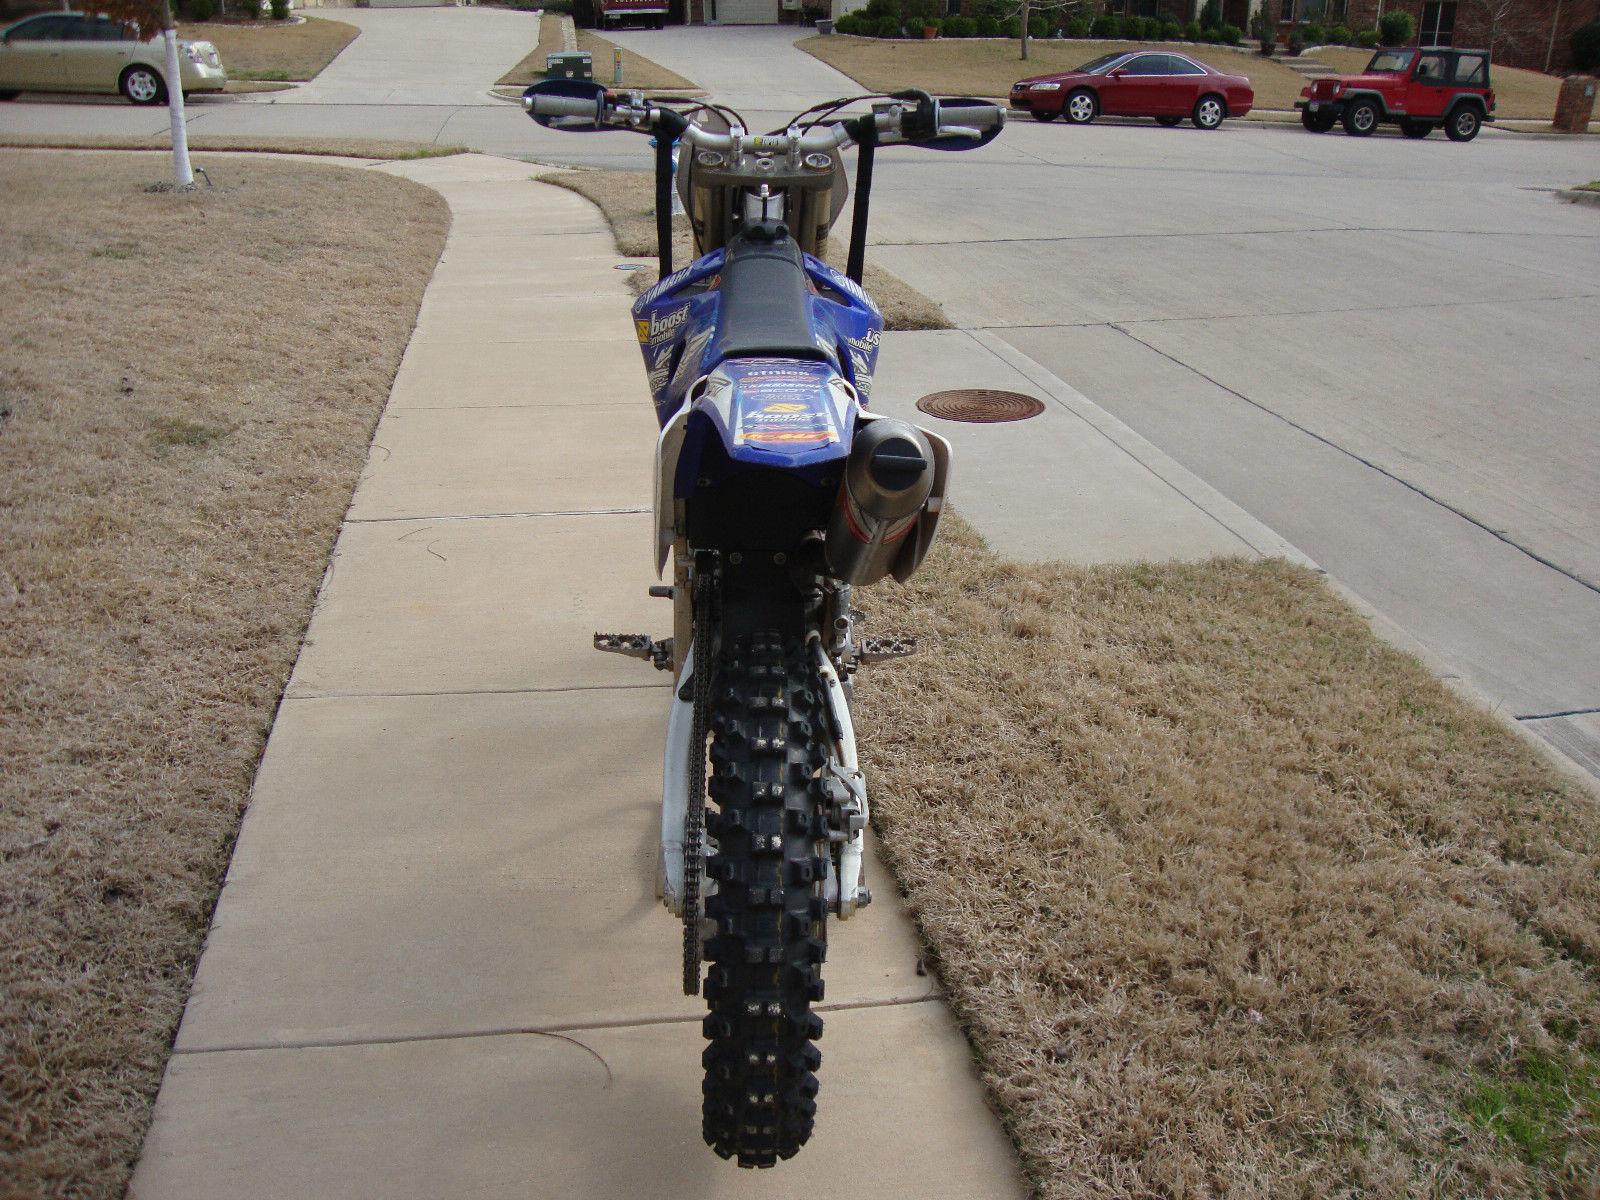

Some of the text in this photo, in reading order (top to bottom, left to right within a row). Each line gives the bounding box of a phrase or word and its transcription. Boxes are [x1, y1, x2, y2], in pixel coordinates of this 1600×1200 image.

[645, 265, 693, 304] YAMAHA
[650, 302, 691, 337] boost
[848, 337, 873, 352] mobile
